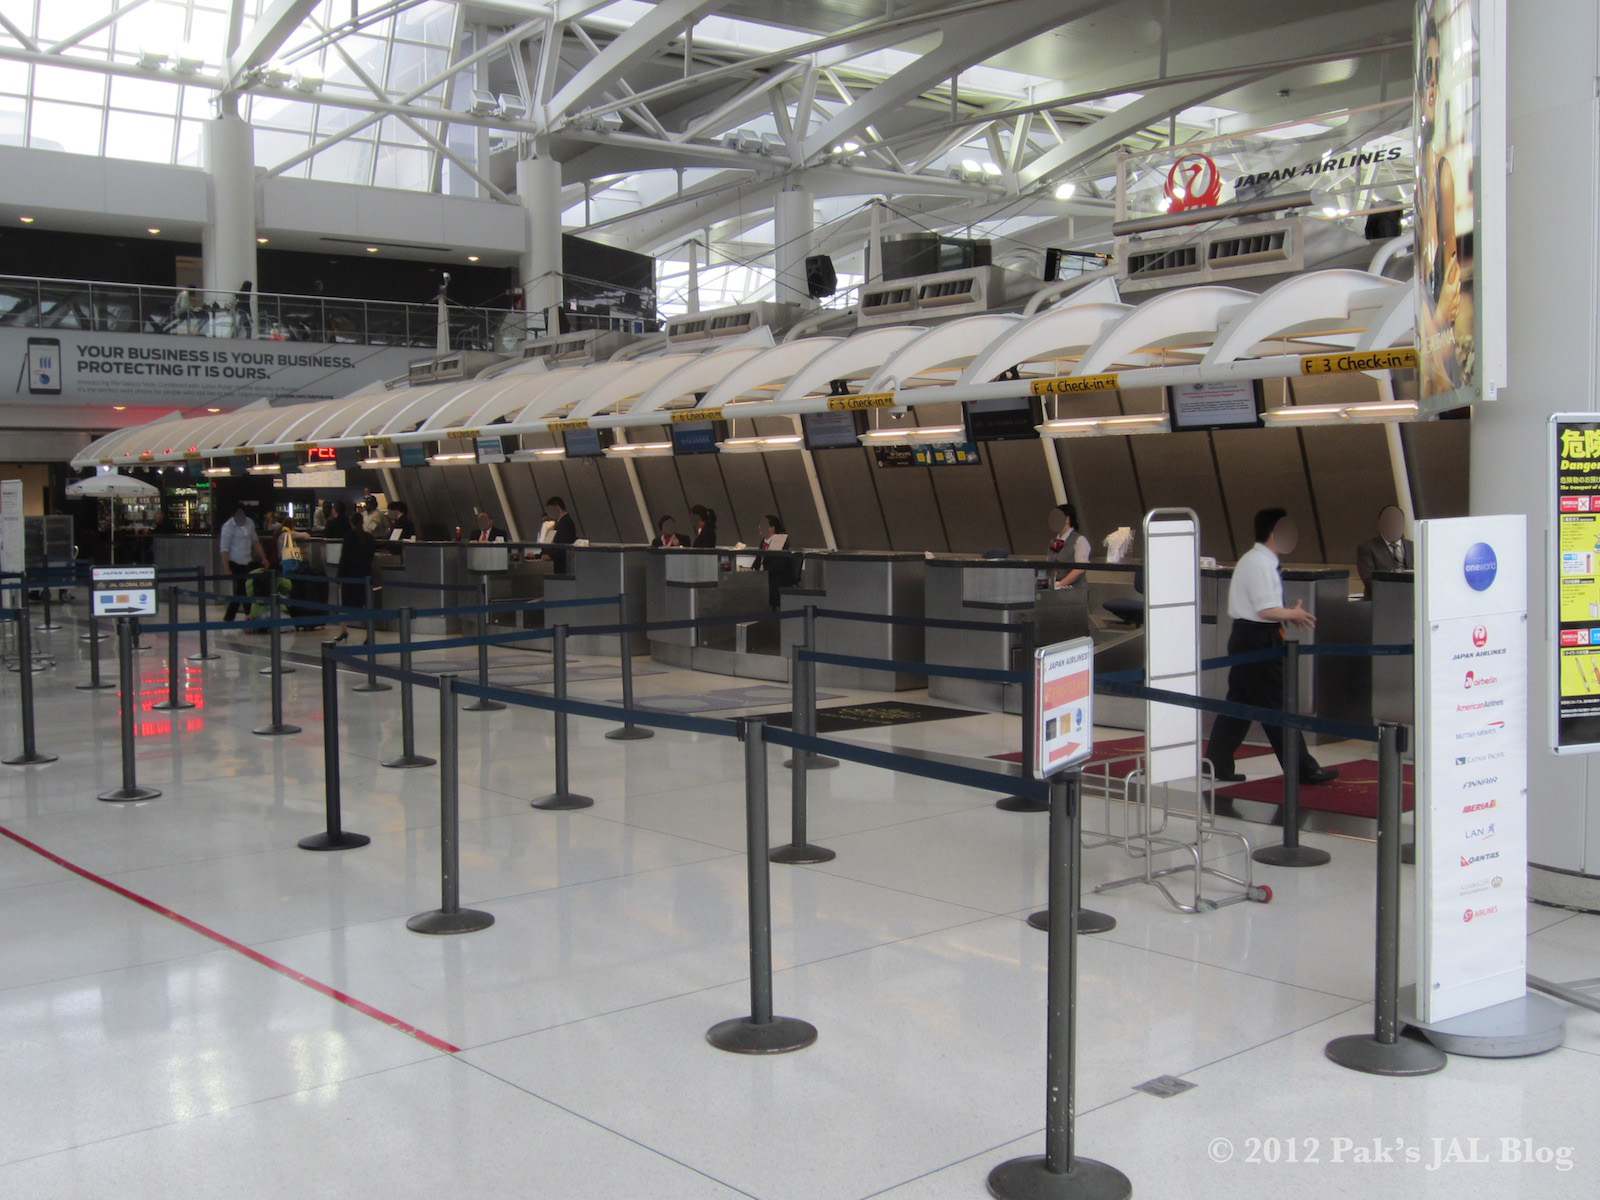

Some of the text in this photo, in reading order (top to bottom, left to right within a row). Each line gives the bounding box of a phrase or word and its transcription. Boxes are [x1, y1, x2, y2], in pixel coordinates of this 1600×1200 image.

[1233, 147, 1401, 189] JAPAN AIRLINES
[77, 345, 355, 368] YOUR BUSINESS IS YOUR BUSINESS.
[1305, 353, 1402, 373] F 3 Check-in
[77, 361, 271, 379] PROTECTING IT IS OURS.
[1033, 379, 1105, 394] F 4 Check-in
[847, 396, 884, 409] Check-in
[1465, 561, 1496, 572] oneworld
[1452, 648, 1507, 661] JAPAN AIRLINES
[1048, 652, 1089, 671] JAPAN AIRLINES
[1473, 676, 1498, 686] airberlin
[1462, 776, 1498, 789] FINNAIR
[1462, 802, 1489, 813] IBERIA
[1465, 828, 1485, 838] LAN
[1468, 851, 1500, 864] QANTAS
[1474, 905, 1498, 917] AIRLINES
